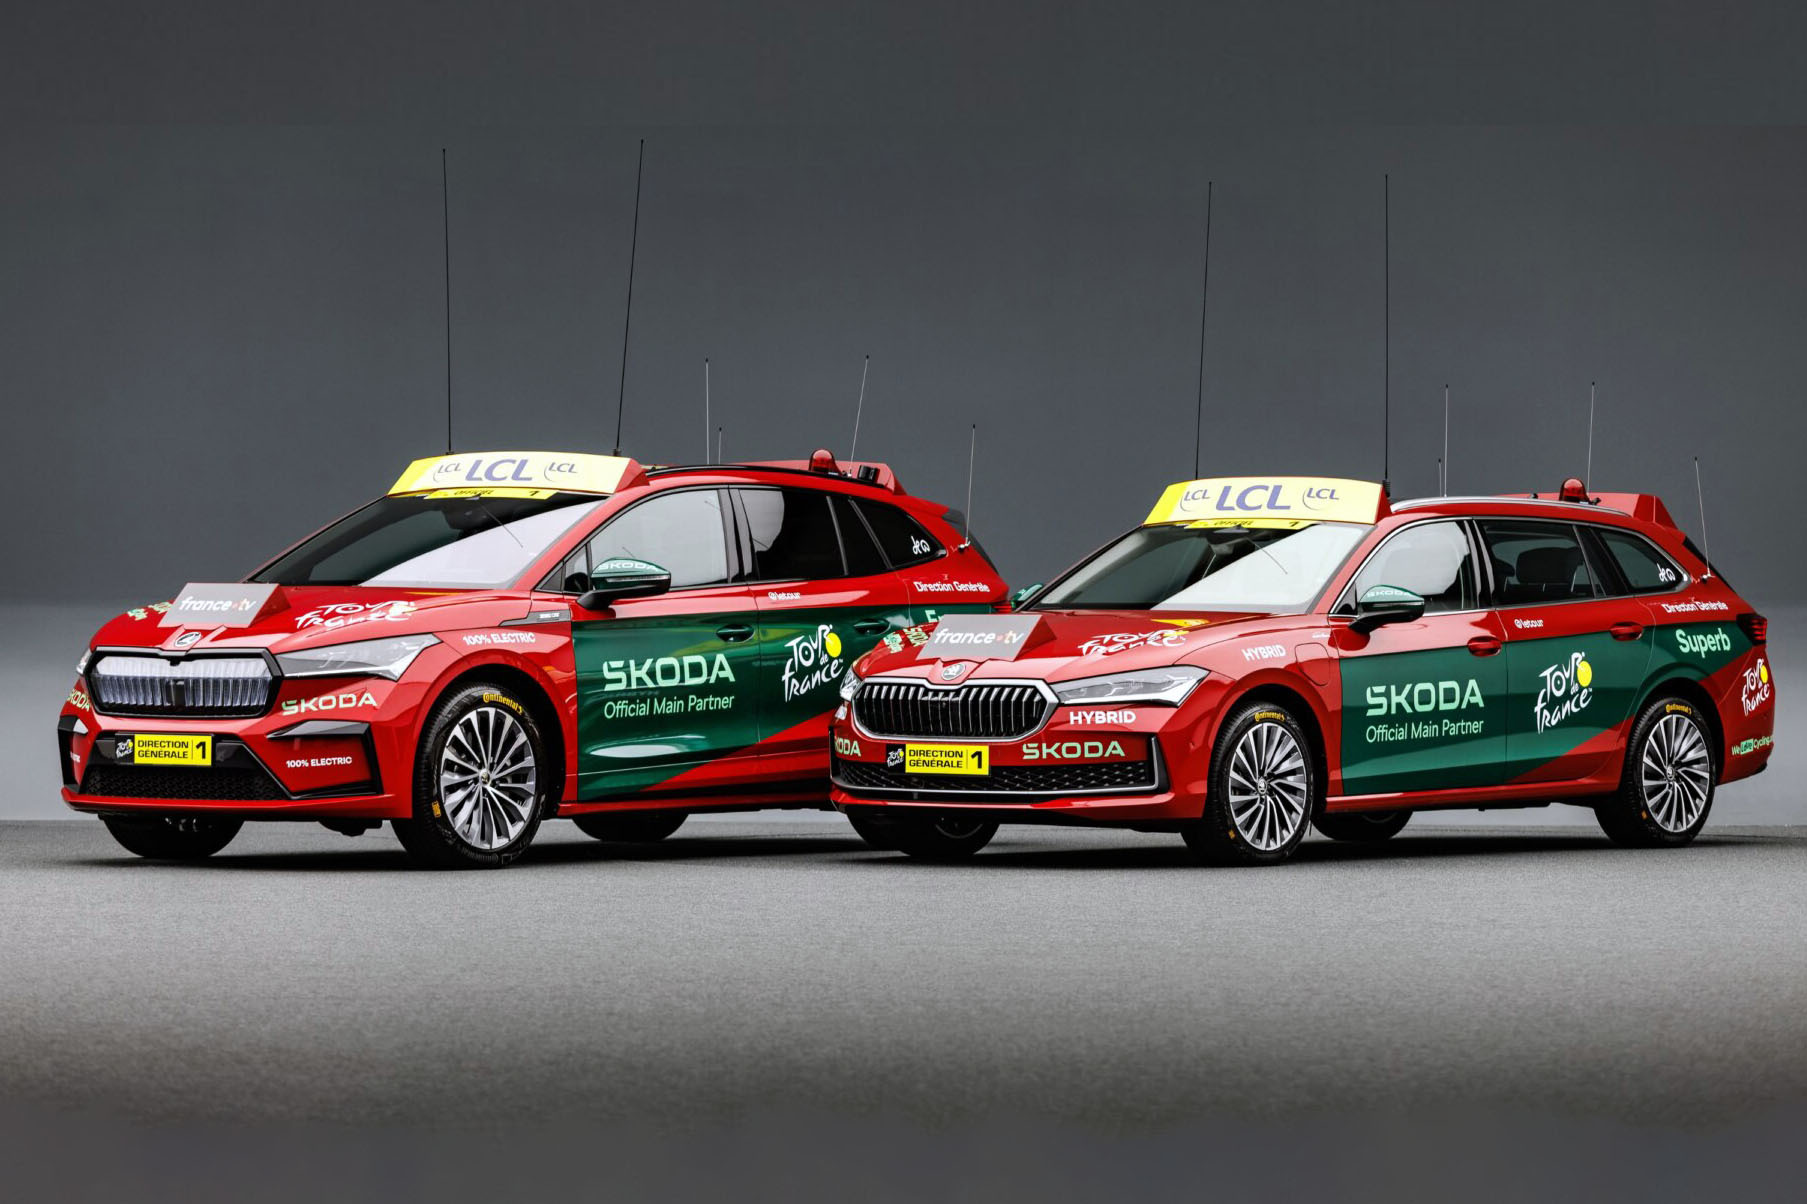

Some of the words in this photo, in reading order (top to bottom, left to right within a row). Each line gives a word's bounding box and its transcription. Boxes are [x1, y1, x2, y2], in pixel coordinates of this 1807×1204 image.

[437, 462, 463, 474] LCL
[465, 458, 533, 482] LCL
[548, 461, 579, 474] LCL
[1183, 489, 1211, 502] LCL
[1215, 484, 1292, 512] LCL
[1305, 487, 1340, 501] LCL
[912, 580, 954, 592] Direction
[1660, 602, 1698, 614] Direction
[462, 634, 493, 646] 100%
[490, 632, 537, 644] ELECTRIC
[1675, 627, 1732, 659] Superb
[1241, 644, 1287, 662] HYBRID
[602, 653, 736, 692] SKODA
[281, 692, 378, 717] SKODA
[482, 691, 521, 713] Continental
[604, 697, 651, 720] Official
[653, 696, 685, 715] Main
[687, 694, 735, 712] Partner
[1366, 679, 1485, 717] SKODA
[1069, 710, 1137, 725] HYBRID
[1366, 722, 1408, 744] Official
[1410, 721, 1439, 739] Main
[1442, 719, 1485, 737] Partner
[137, 739, 189, 749] DIRECTION
[195, 741, 207, 760] 1
[1022, 740, 1126, 760] SKODA
[286, 759, 310, 769] 100%
[310, 756, 353, 768] ELECTRIC
[908, 749, 964, 759] DIRECTION
[908, 758, 963, 769] GÉNÉRALE
[970, 750, 983, 769] 1
